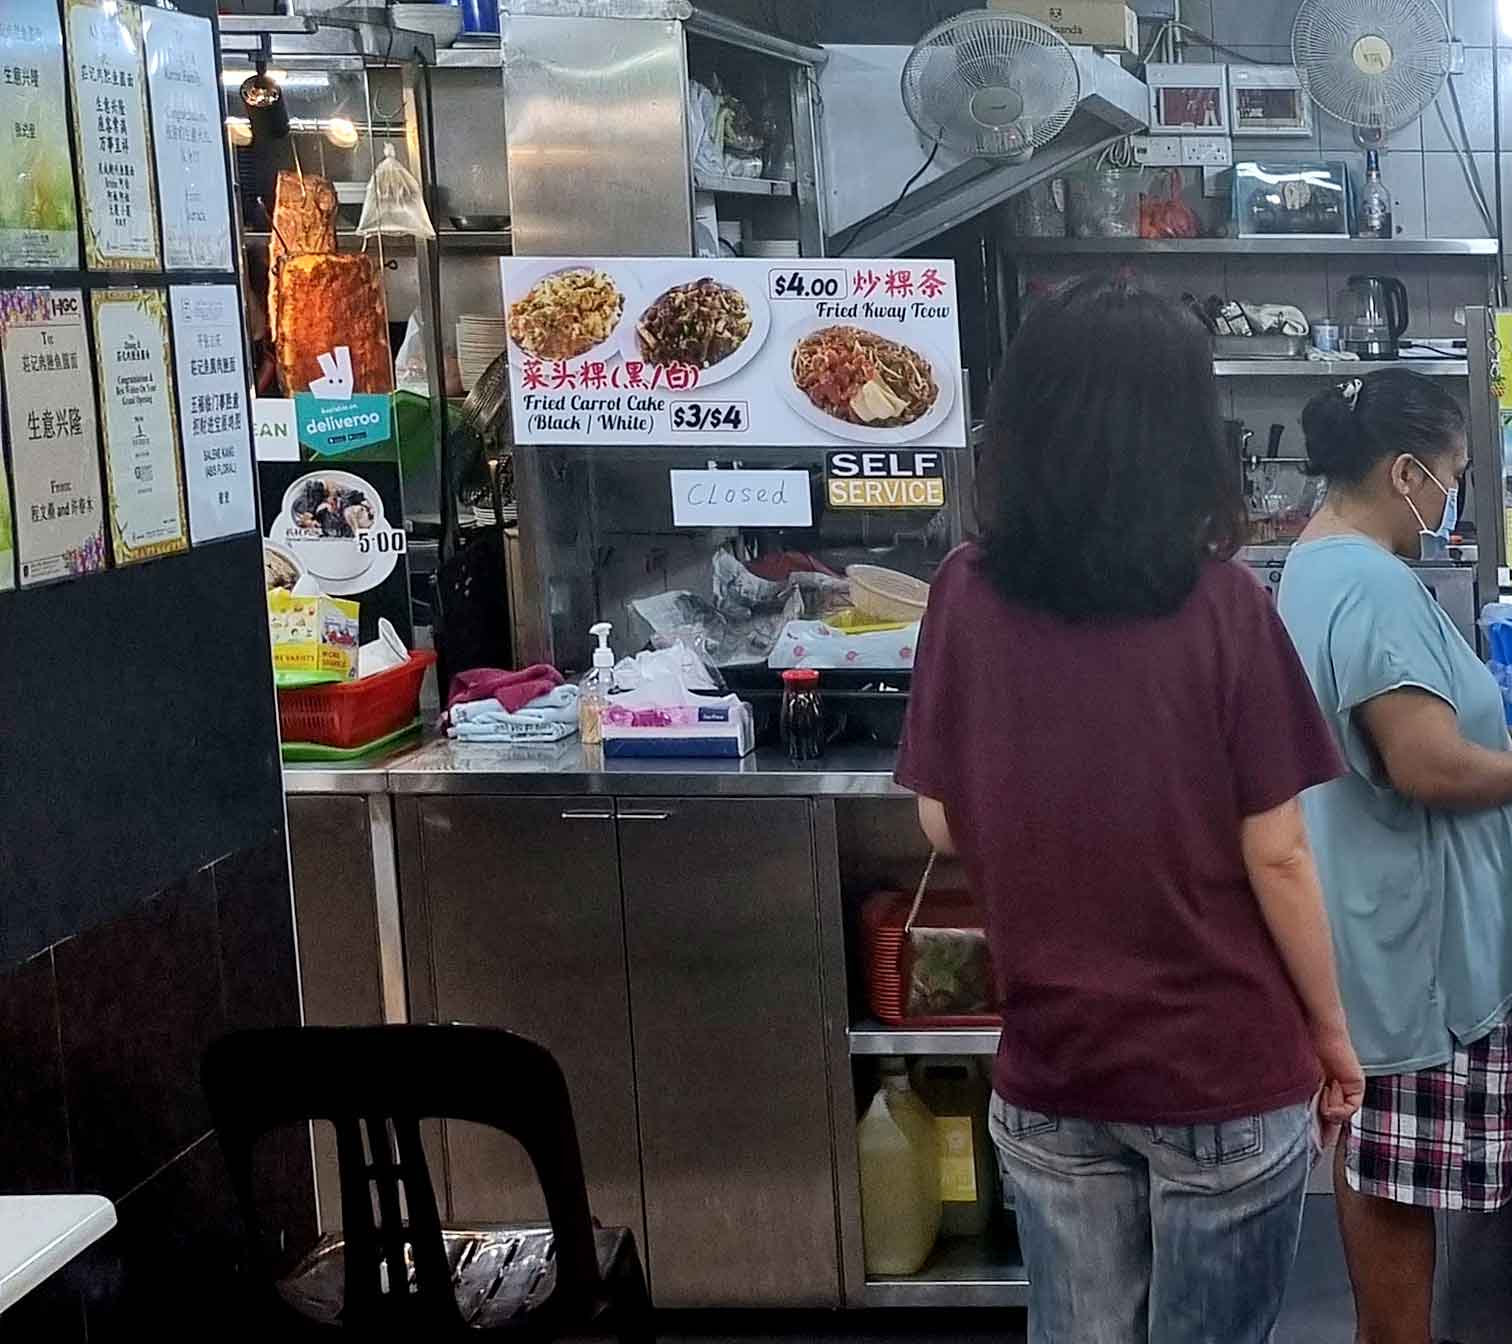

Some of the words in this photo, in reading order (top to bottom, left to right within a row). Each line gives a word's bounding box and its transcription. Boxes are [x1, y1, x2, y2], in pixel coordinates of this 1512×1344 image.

[775, 271, 838, 297] $4.00
[852, 269, 948, 299] 炒粿条
[51, 297, 78, 317] HGC
[816, 302, 858, 318] Fried
[862, 302, 907, 322] Kway
[910, 303, 950, 318] Teow
[523, 395, 565, 411] Fried
[570, 394, 622, 412] Carrot
[627, 394, 665, 412] Cake
[27, 407, 84, 442] 生意兴隆
[306, 412, 380, 435] deliveroo
[527, 414, 582, 433] (Black
[596, 415, 656, 433] White)
[673, 404, 742, 430] $3/$4
[831, 454, 939, 476] SELF
[832, 480, 945, 504] SERVICE
